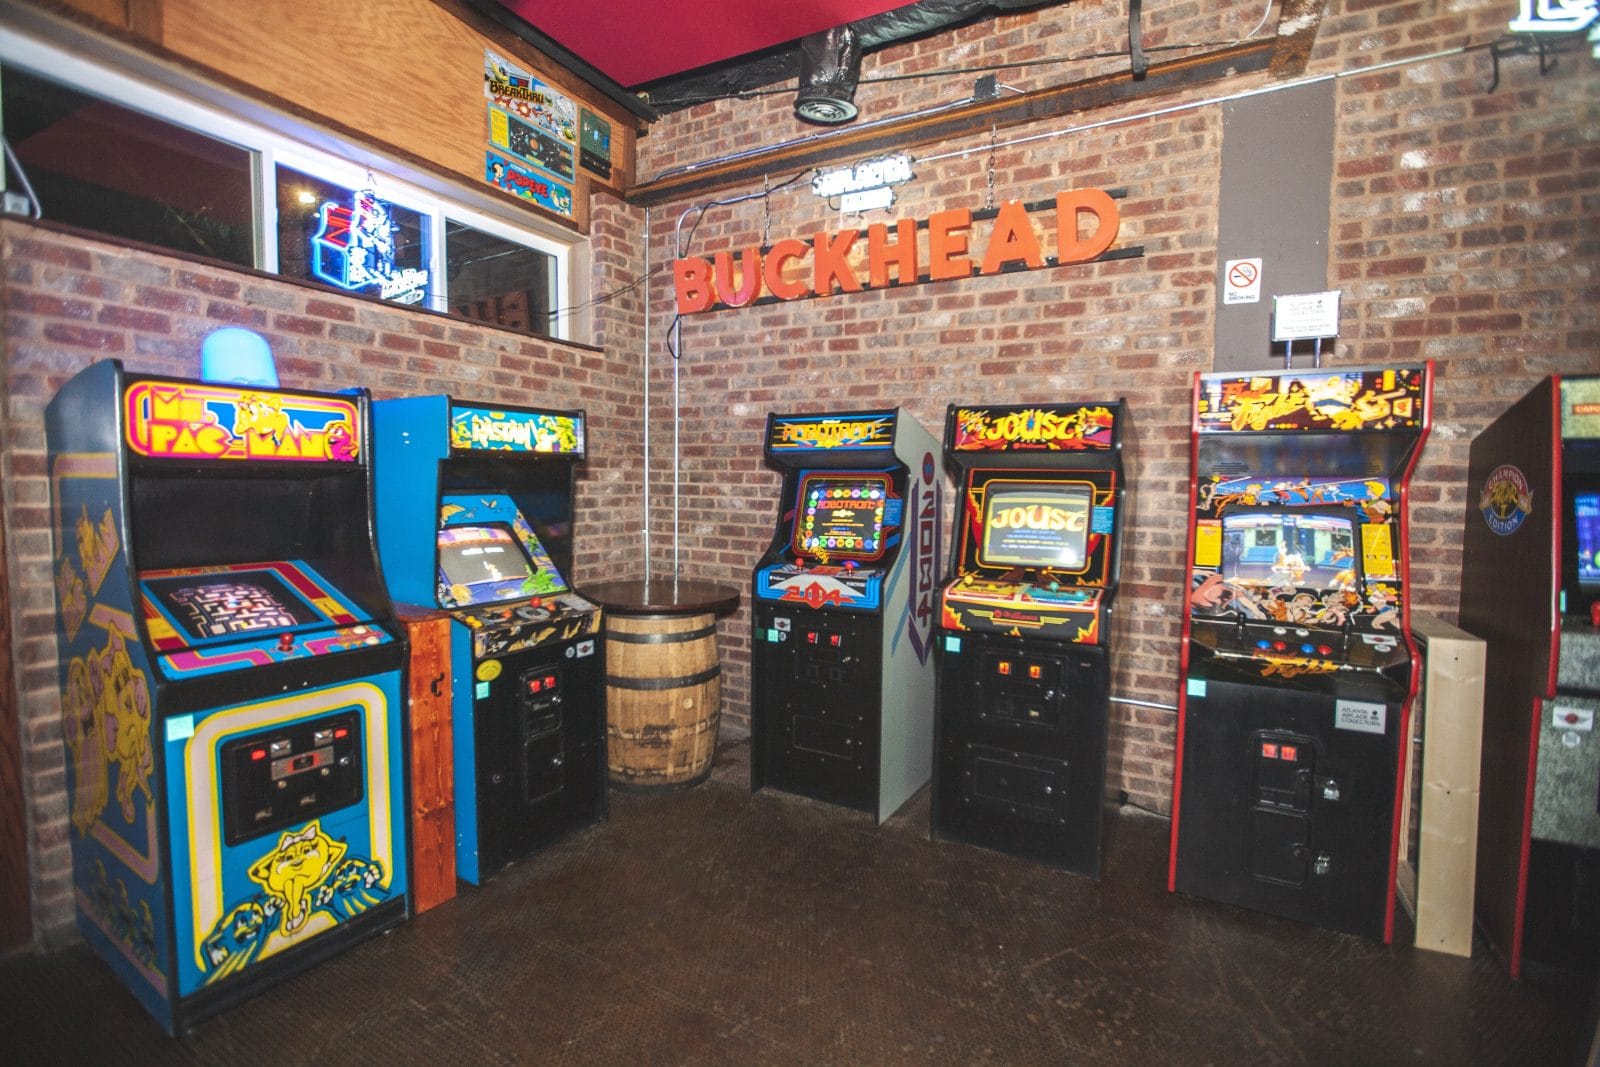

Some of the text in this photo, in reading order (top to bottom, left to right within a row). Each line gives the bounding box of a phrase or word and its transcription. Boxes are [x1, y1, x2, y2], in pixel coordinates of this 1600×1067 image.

[505, 169, 549, 198] POPEYE
[674, 187, 1121, 315] BUCKHEAD
[782, 421, 877, 442] ROBOTRON
[987, 409, 1080, 441] JOUST
[1488, 468, 1523, 491] CHAMPION
[990, 504, 1086, 532] JOUST
[1488, 513, 1518, 532] EDITION
[1341, 707, 1368, 715] ATLANTA
[1341, 712, 1368, 720] ARCADE
